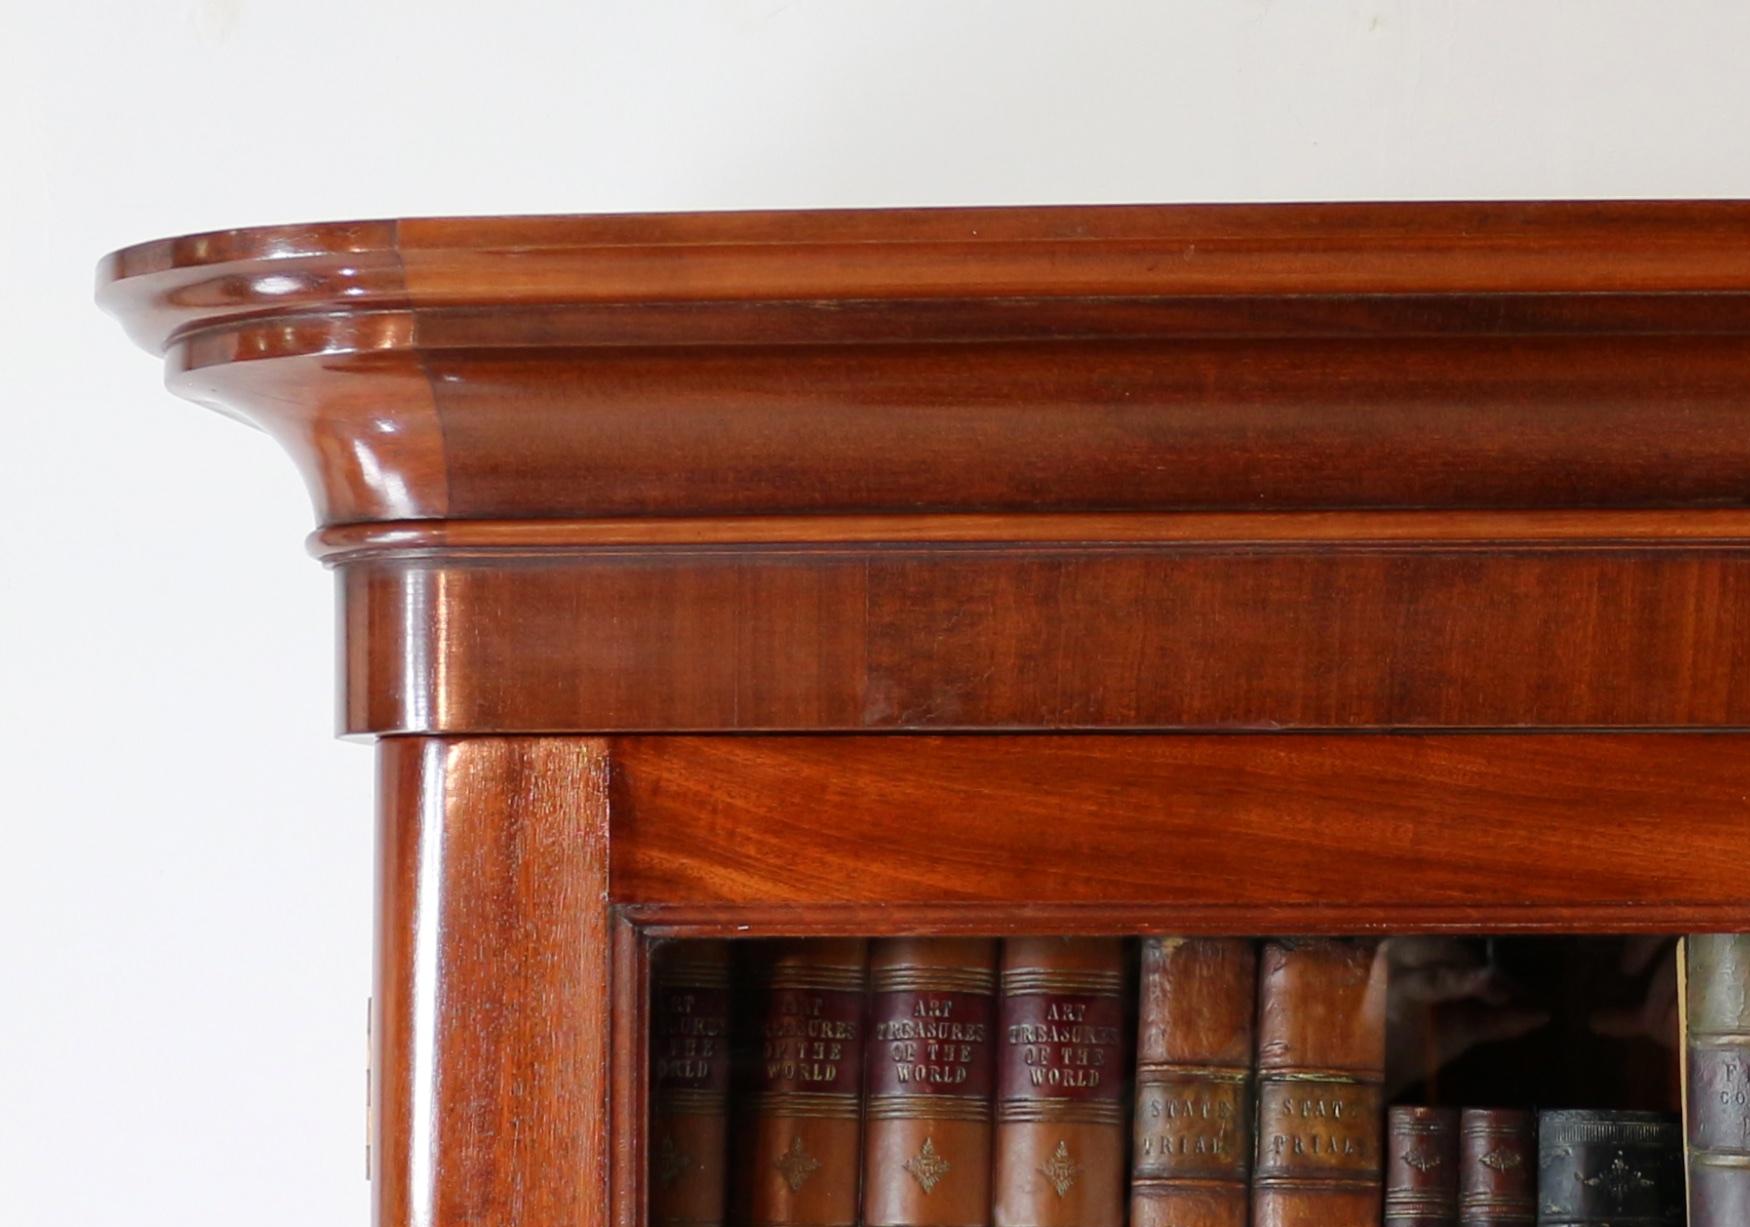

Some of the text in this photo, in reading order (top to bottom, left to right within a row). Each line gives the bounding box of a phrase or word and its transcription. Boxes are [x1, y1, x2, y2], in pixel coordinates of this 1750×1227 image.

[912, 999, 952, 1018] ART
[1047, 1002, 1086, 1022] ART
[875, 1018, 987, 1042] TREASURES
[1008, 1023, 1119, 1045] TREASURES
[799, 1041, 843, 1061] THE
[891, 1042, 972, 1063] OF THE
[1025, 1045, 1106, 1066] OF THE
[767, 1063, 838, 1082] WORLD
[896, 1065, 967, 1084] WORLD
[1029, 1067, 1100, 1088] WORLD
